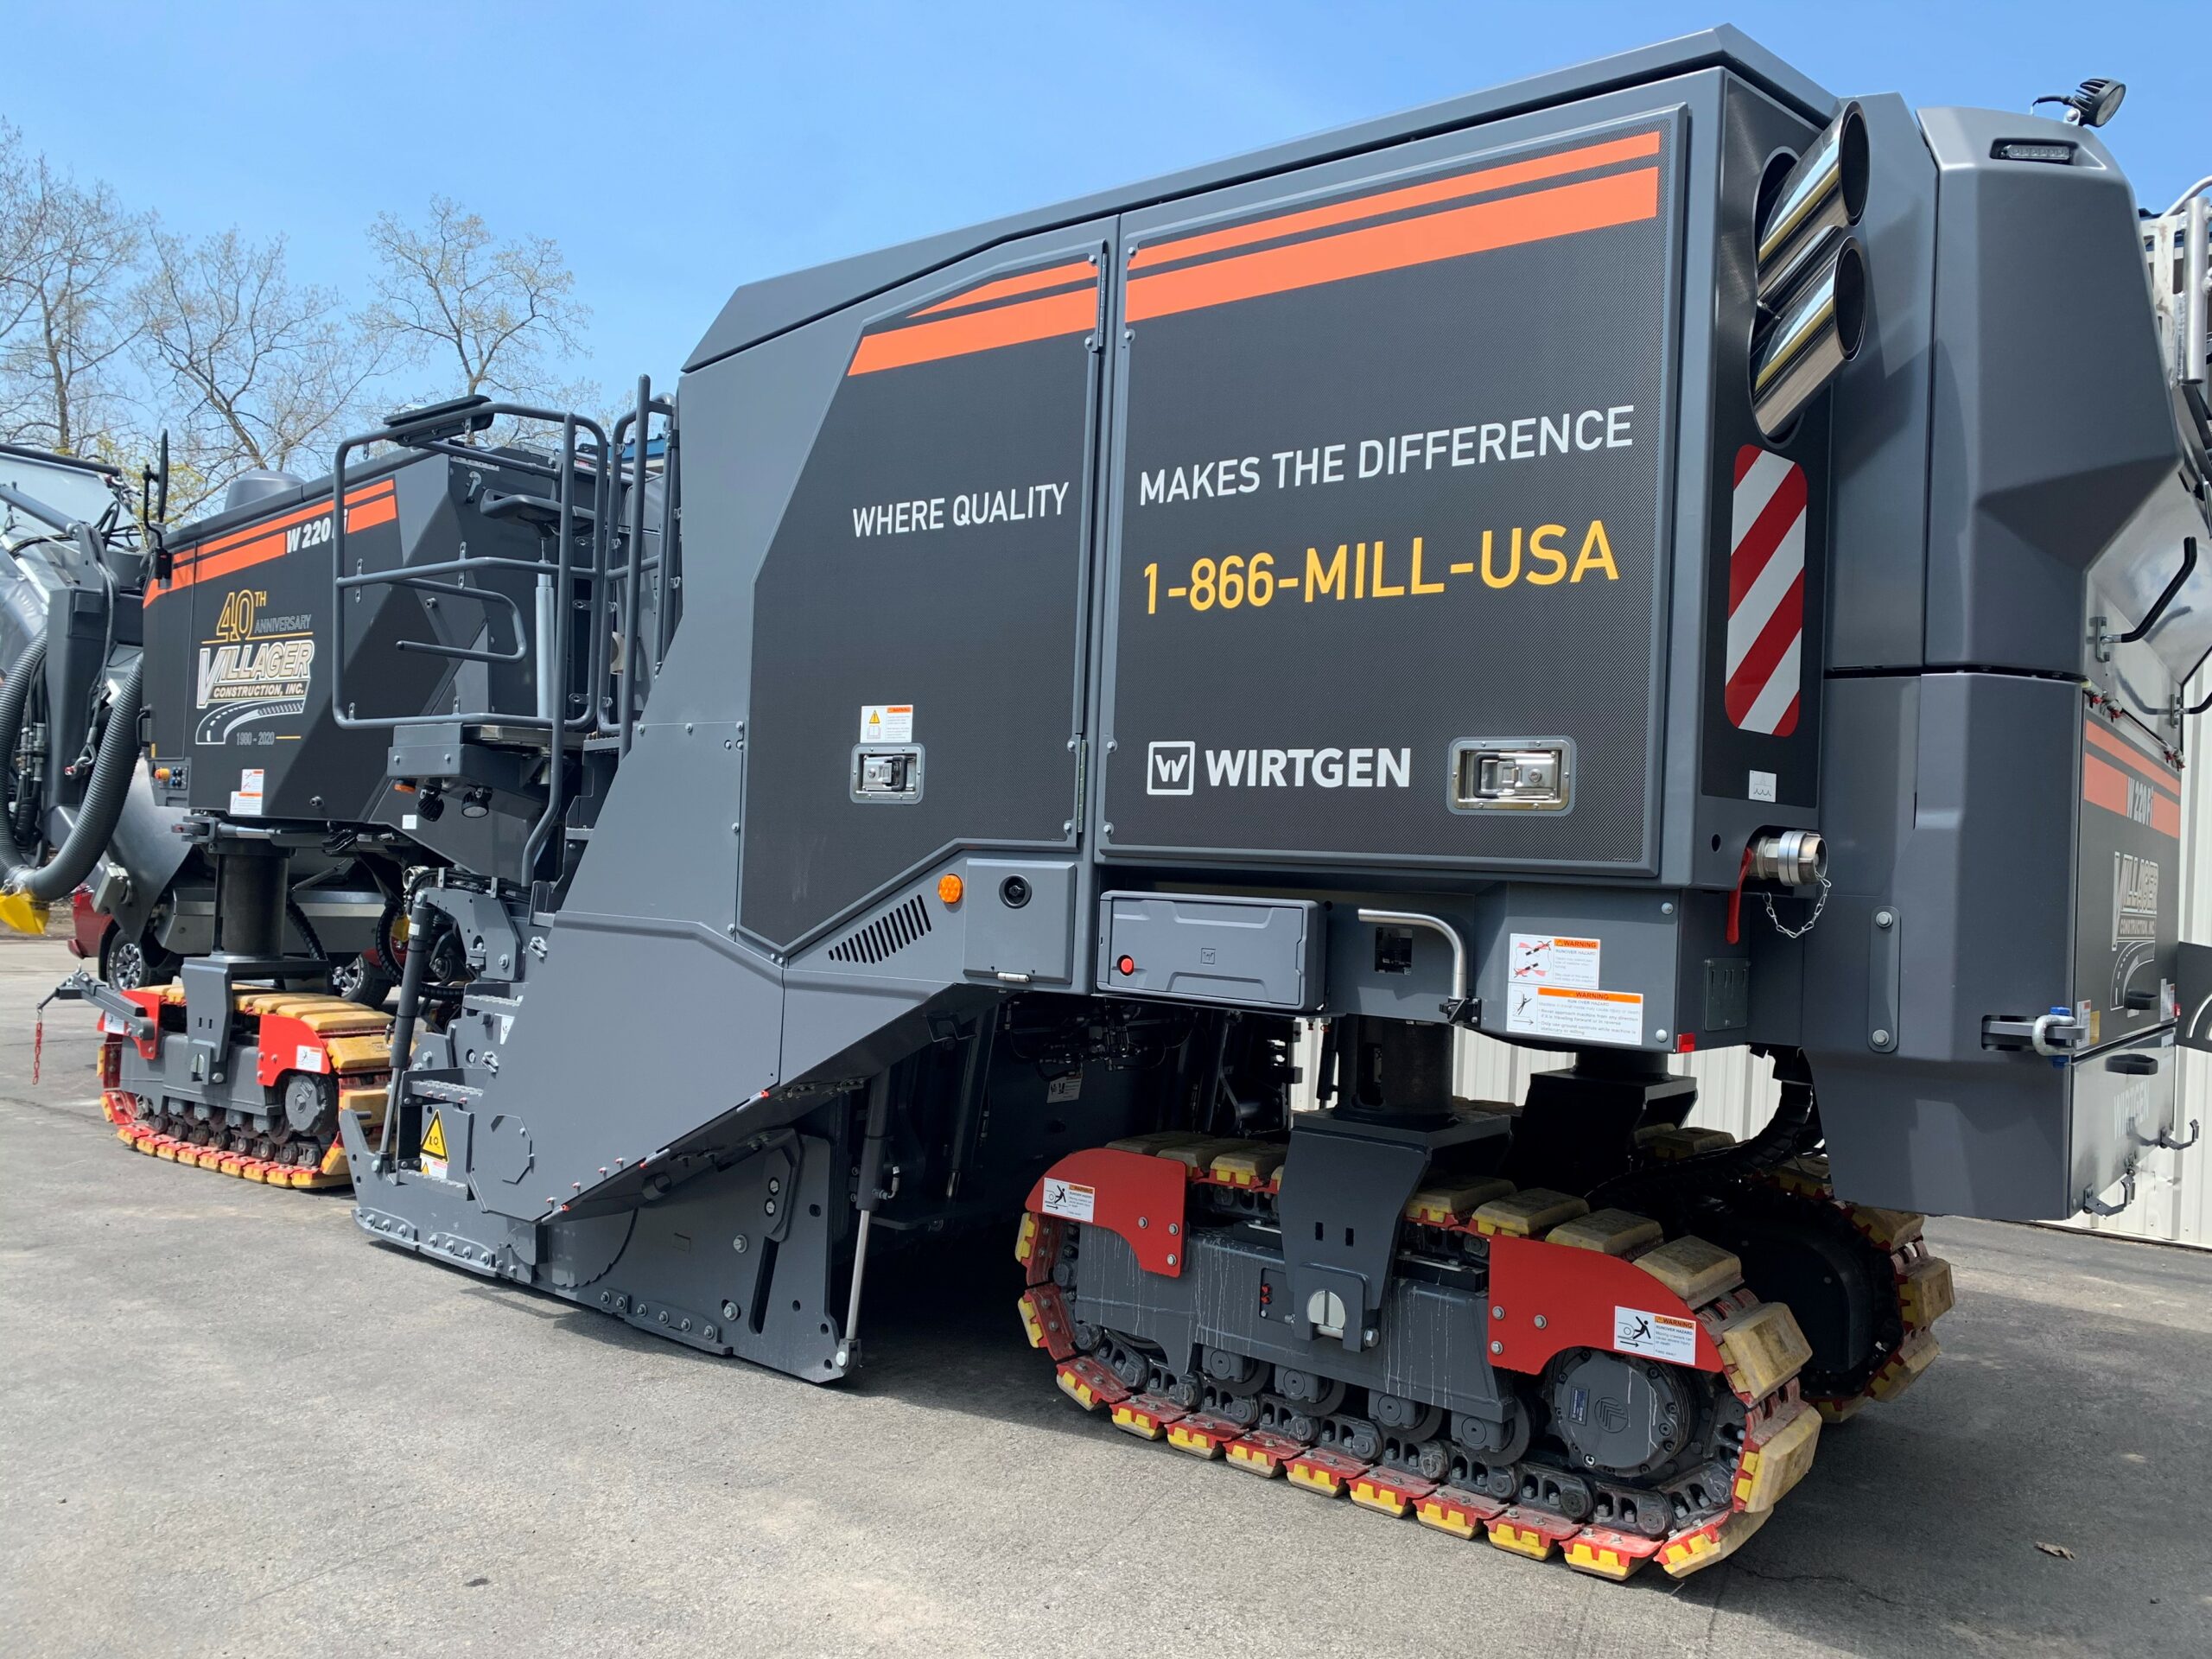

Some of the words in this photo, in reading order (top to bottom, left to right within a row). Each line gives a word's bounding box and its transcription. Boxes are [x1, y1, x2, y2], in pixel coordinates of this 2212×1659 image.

[1140, 457, 1260, 506] MAKES
[1273, 444, 1345, 488] THE
[1358, 405, 1634, 479] DIFFERENCE
[853, 498, 945, 537] WHERE
[953, 481, 1070, 525] QUALITY
[287, 527, 302, 554] W
[1143, 520, 1621, 614] 1-866-MILL-USA
[254, 614, 312, 634] ANNIVERSARY
[196, 639, 315, 709] VILLAGER
[213, 684, 283, 698] CONSTRUCTION,
[285, 683, 304, 695] INC.
[257, 731, 275, 746] 2020
[1205, 747, 1411, 788] WIRTGEN
[2112, 851, 2158, 952] VILLAGER
[1662, 1318, 1693, 1328] WARNING
